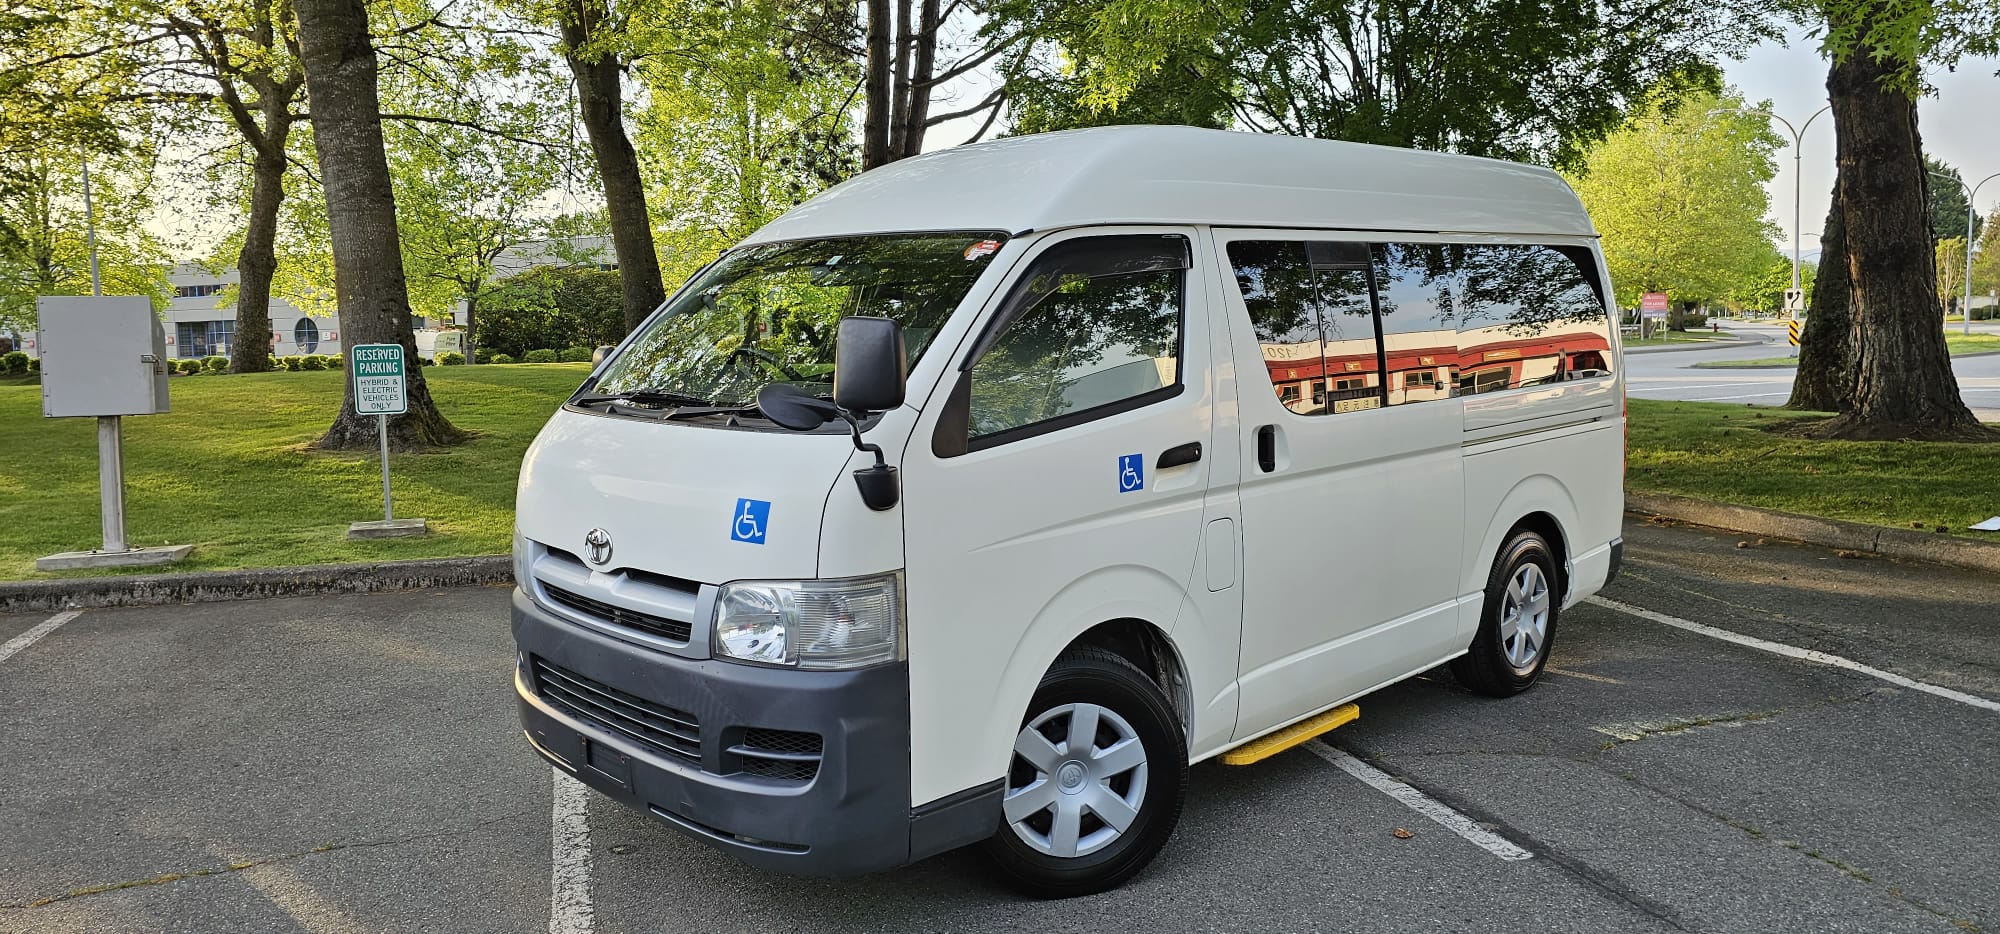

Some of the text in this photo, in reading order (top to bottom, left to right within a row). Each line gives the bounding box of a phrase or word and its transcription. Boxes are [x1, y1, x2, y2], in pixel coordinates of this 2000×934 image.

[356, 349, 400, 360] RESERVED
[360, 362, 398, 374] PARKING
[363, 386, 398, 394] ELECTRIC
[363, 394, 399, 402] VEHICLES
[371, 402, 392, 410] ONLY
